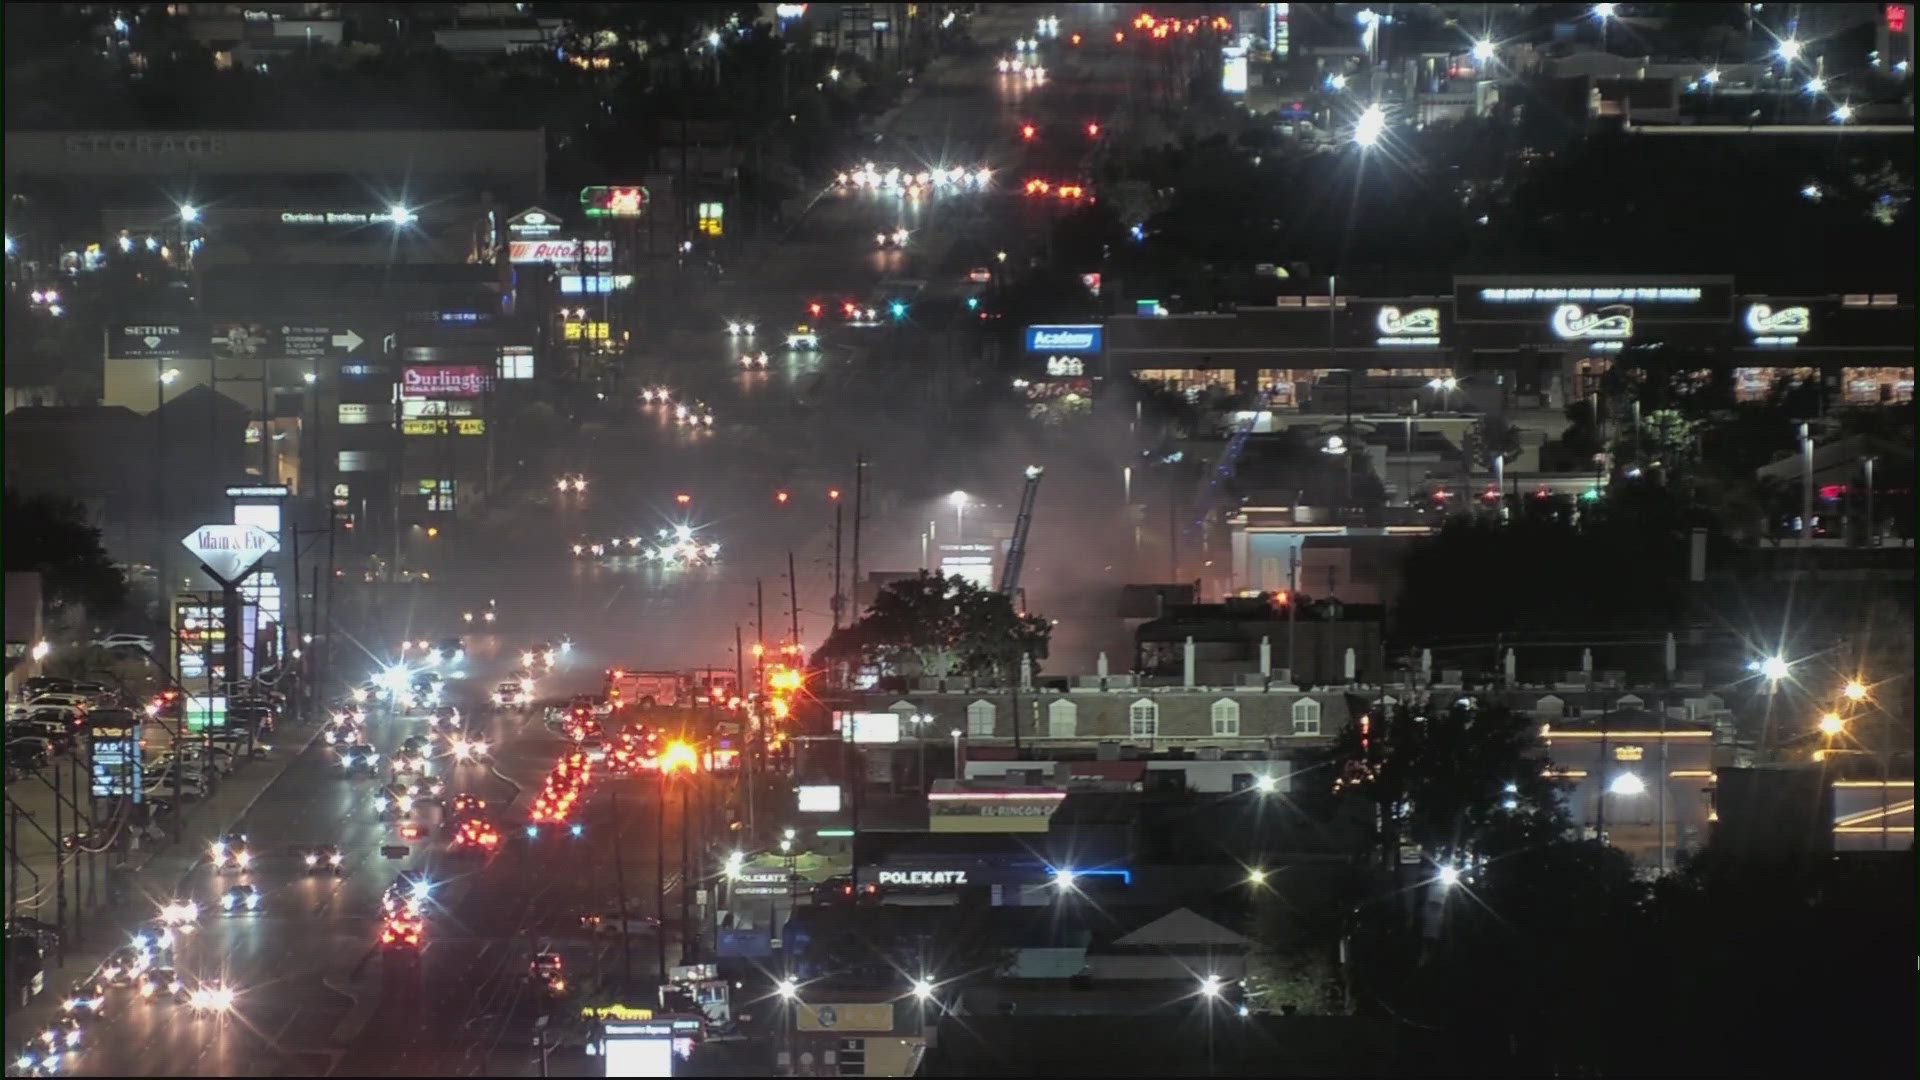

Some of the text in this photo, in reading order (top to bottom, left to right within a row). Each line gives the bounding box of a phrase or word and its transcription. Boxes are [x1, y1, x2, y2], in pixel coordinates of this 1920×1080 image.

[64, 134, 224, 155] STORAGE
[535, 243, 610, 258] AutoZone
[1034, 331, 1093, 349] Academy
[198, 531, 229, 550] Adam
[245, 531, 266, 550] Eve
[879, 870, 968, 885] POLEKATZ
